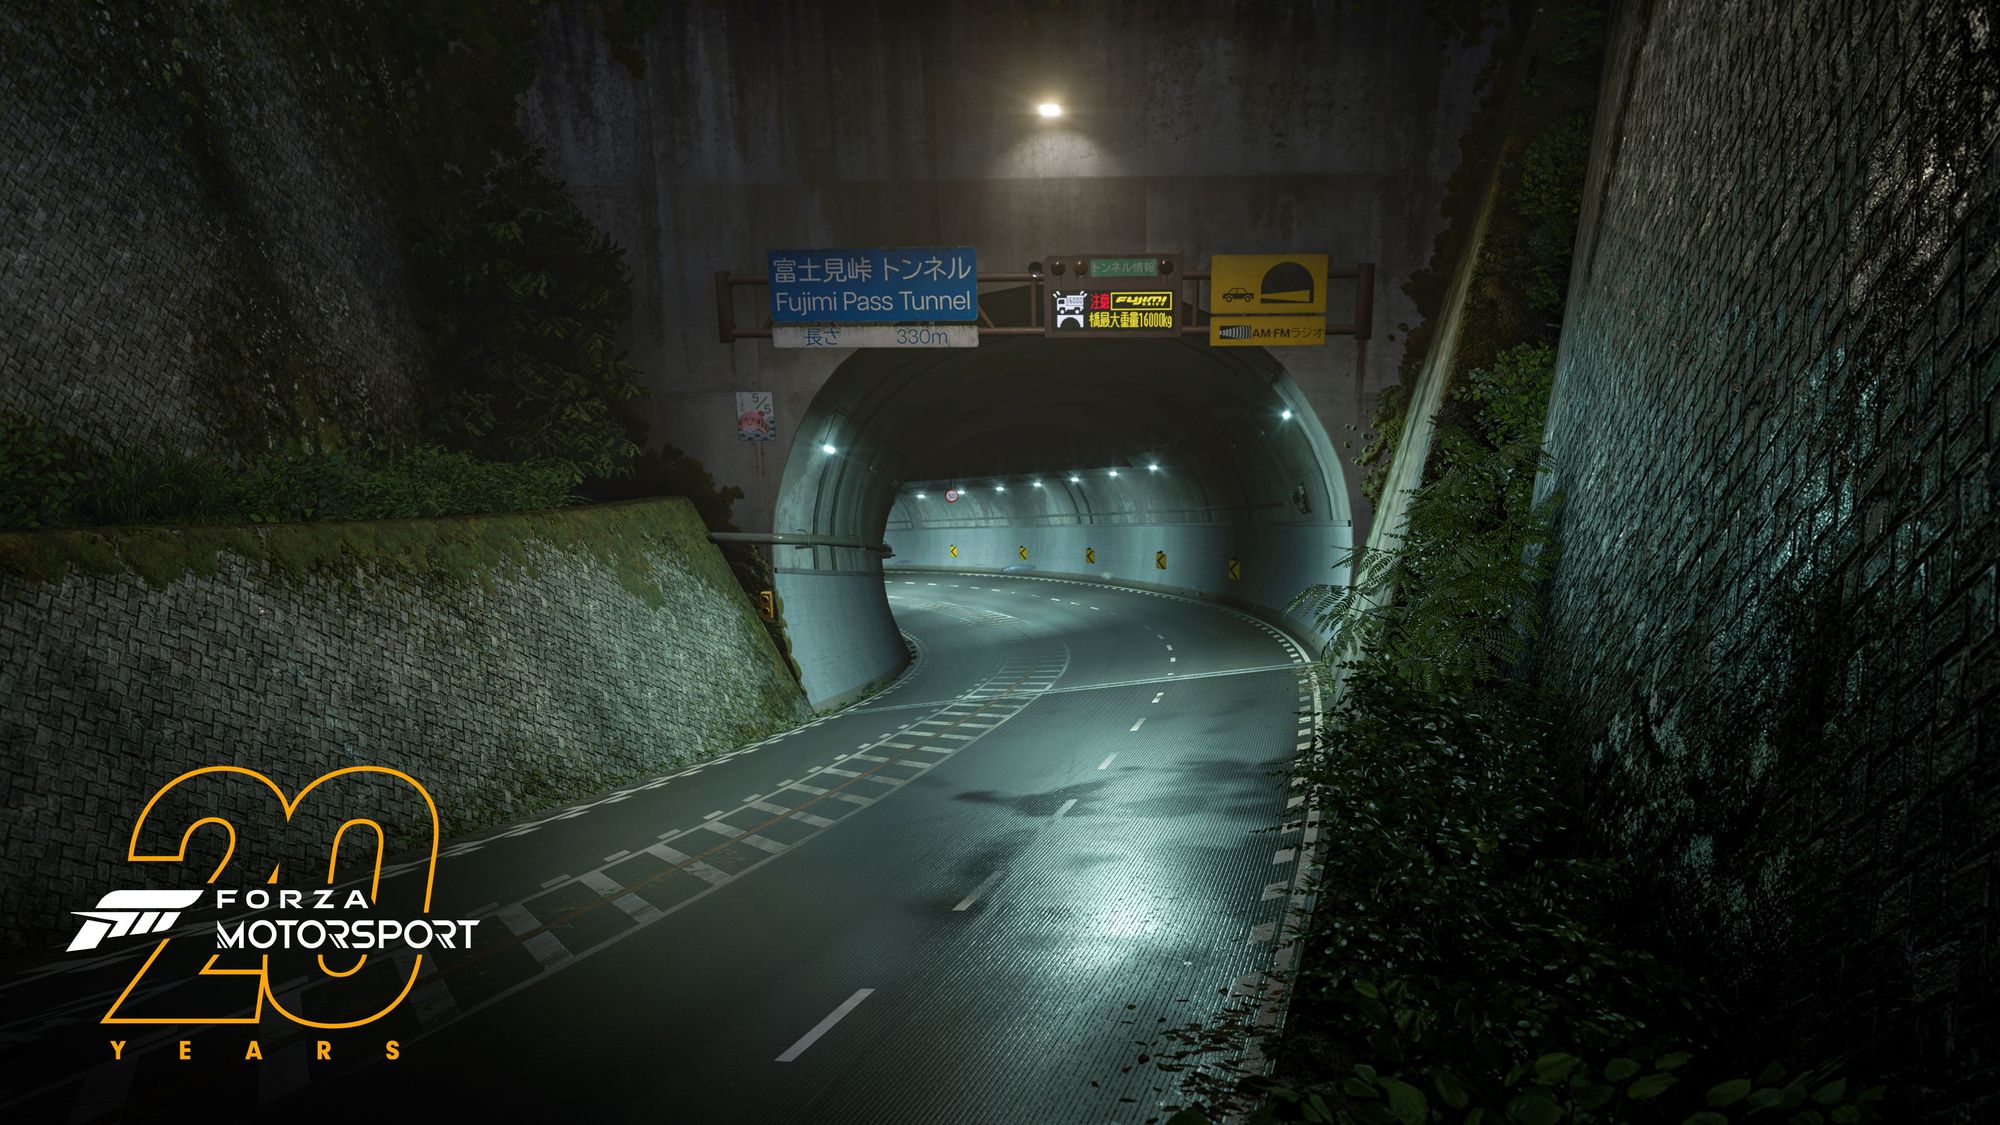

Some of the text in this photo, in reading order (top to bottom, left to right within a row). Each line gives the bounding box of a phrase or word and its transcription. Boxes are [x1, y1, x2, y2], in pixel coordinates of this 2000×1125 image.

[773, 256, 971, 283] 富士見峠 トンネル
[776, 290, 971, 316] Fujimi Pass Tunnel
[804, 328, 948, 346] 長さ 330m
